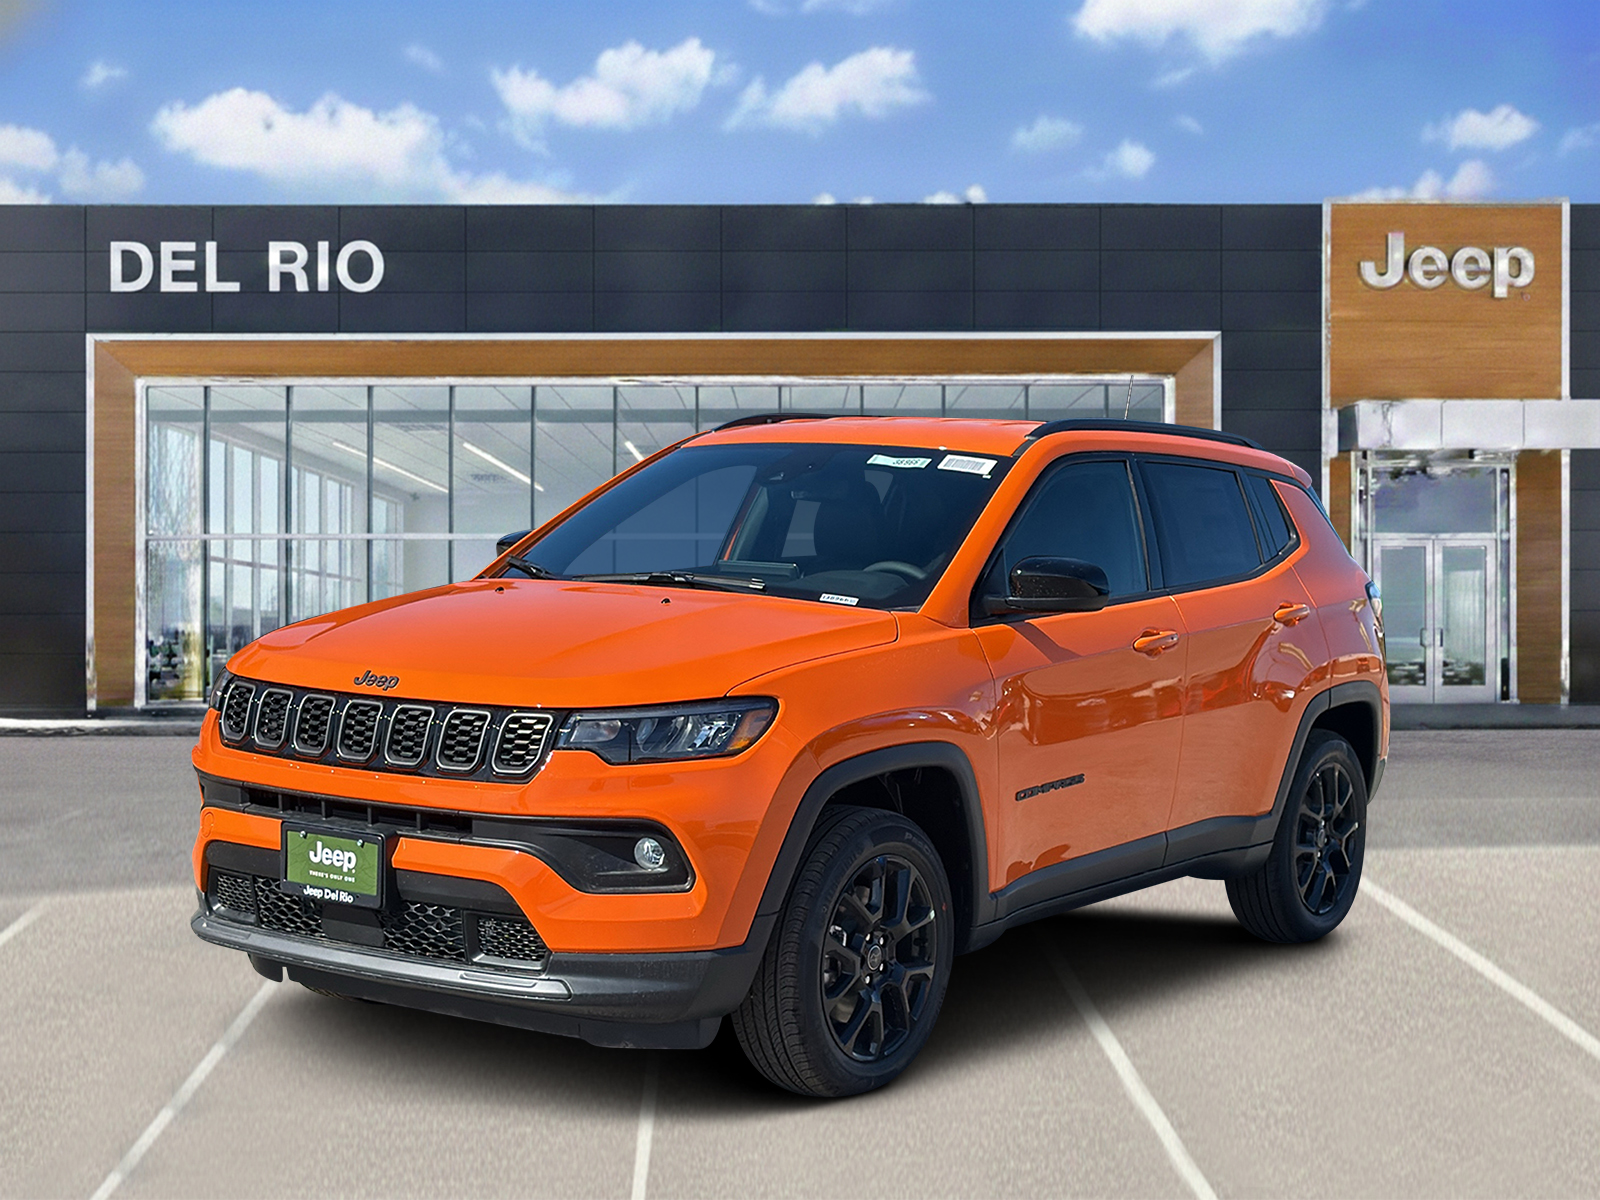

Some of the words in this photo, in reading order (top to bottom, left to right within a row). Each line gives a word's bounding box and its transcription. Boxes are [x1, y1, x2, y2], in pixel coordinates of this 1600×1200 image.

[109, 240, 241, 293] DEL
[267, 239, 385, 293] RIO
[1358, 231, 1536, 299] Jeep
[353, 669, 400, 691] Jeep
[1015, 773, 1085, 801] COMPASS
[308, 840, 357, 873] Jeep
[309, 869, 329, 879] THERE'S
[329, 873, 344, 881] ONLY
[344, 875, 356, 883] ONE
[303, 884, 324, 899] Jeep
[323, 888, 339, 901] Del
[339, 890, 354, 904] Rio
